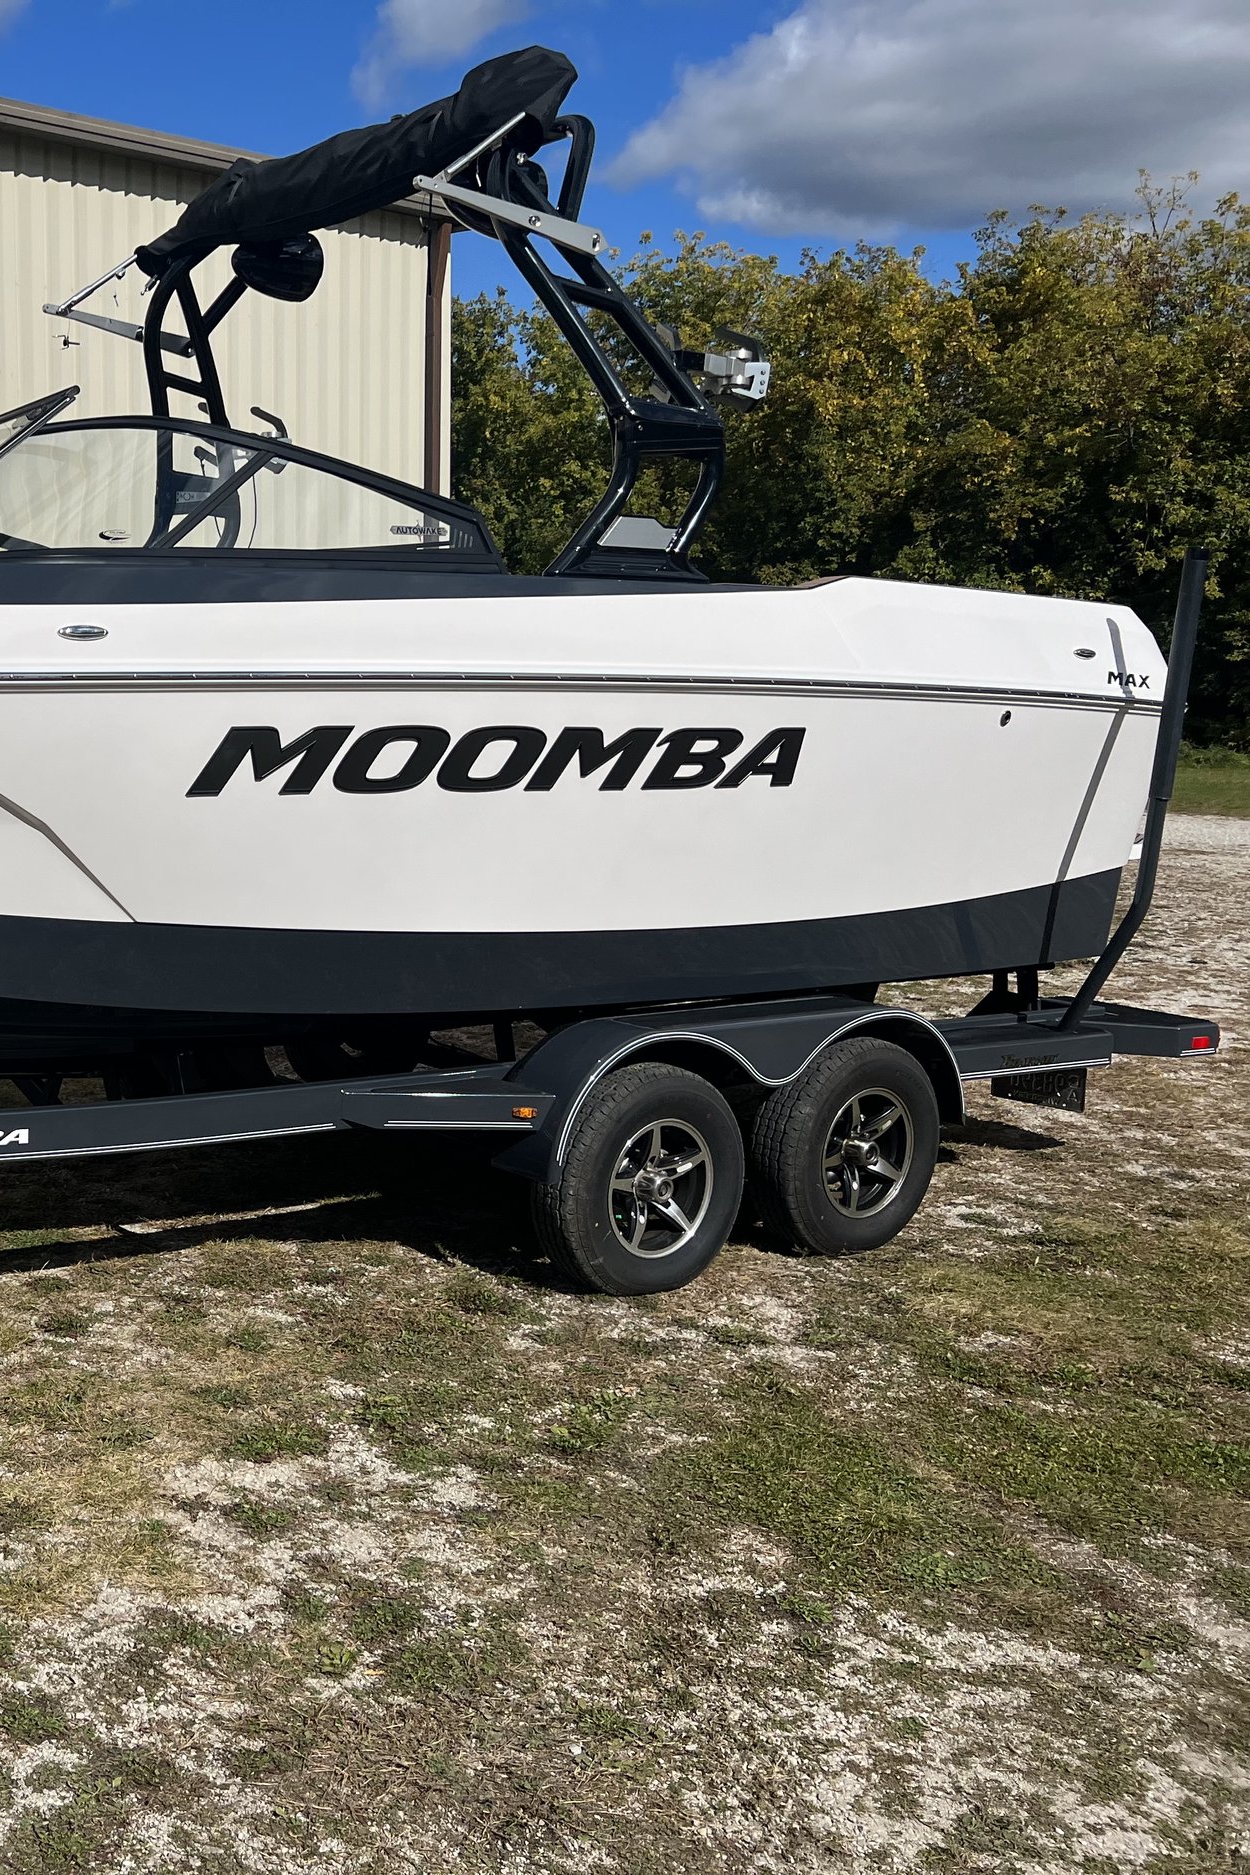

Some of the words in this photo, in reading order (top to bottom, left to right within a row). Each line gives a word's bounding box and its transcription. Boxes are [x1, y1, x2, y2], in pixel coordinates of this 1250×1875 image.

[396, 526, 442, 536] AUTOWAKE
[1107, 671, 1150, 689] MAX
[185, 725, 806, 798] MOOMBA
